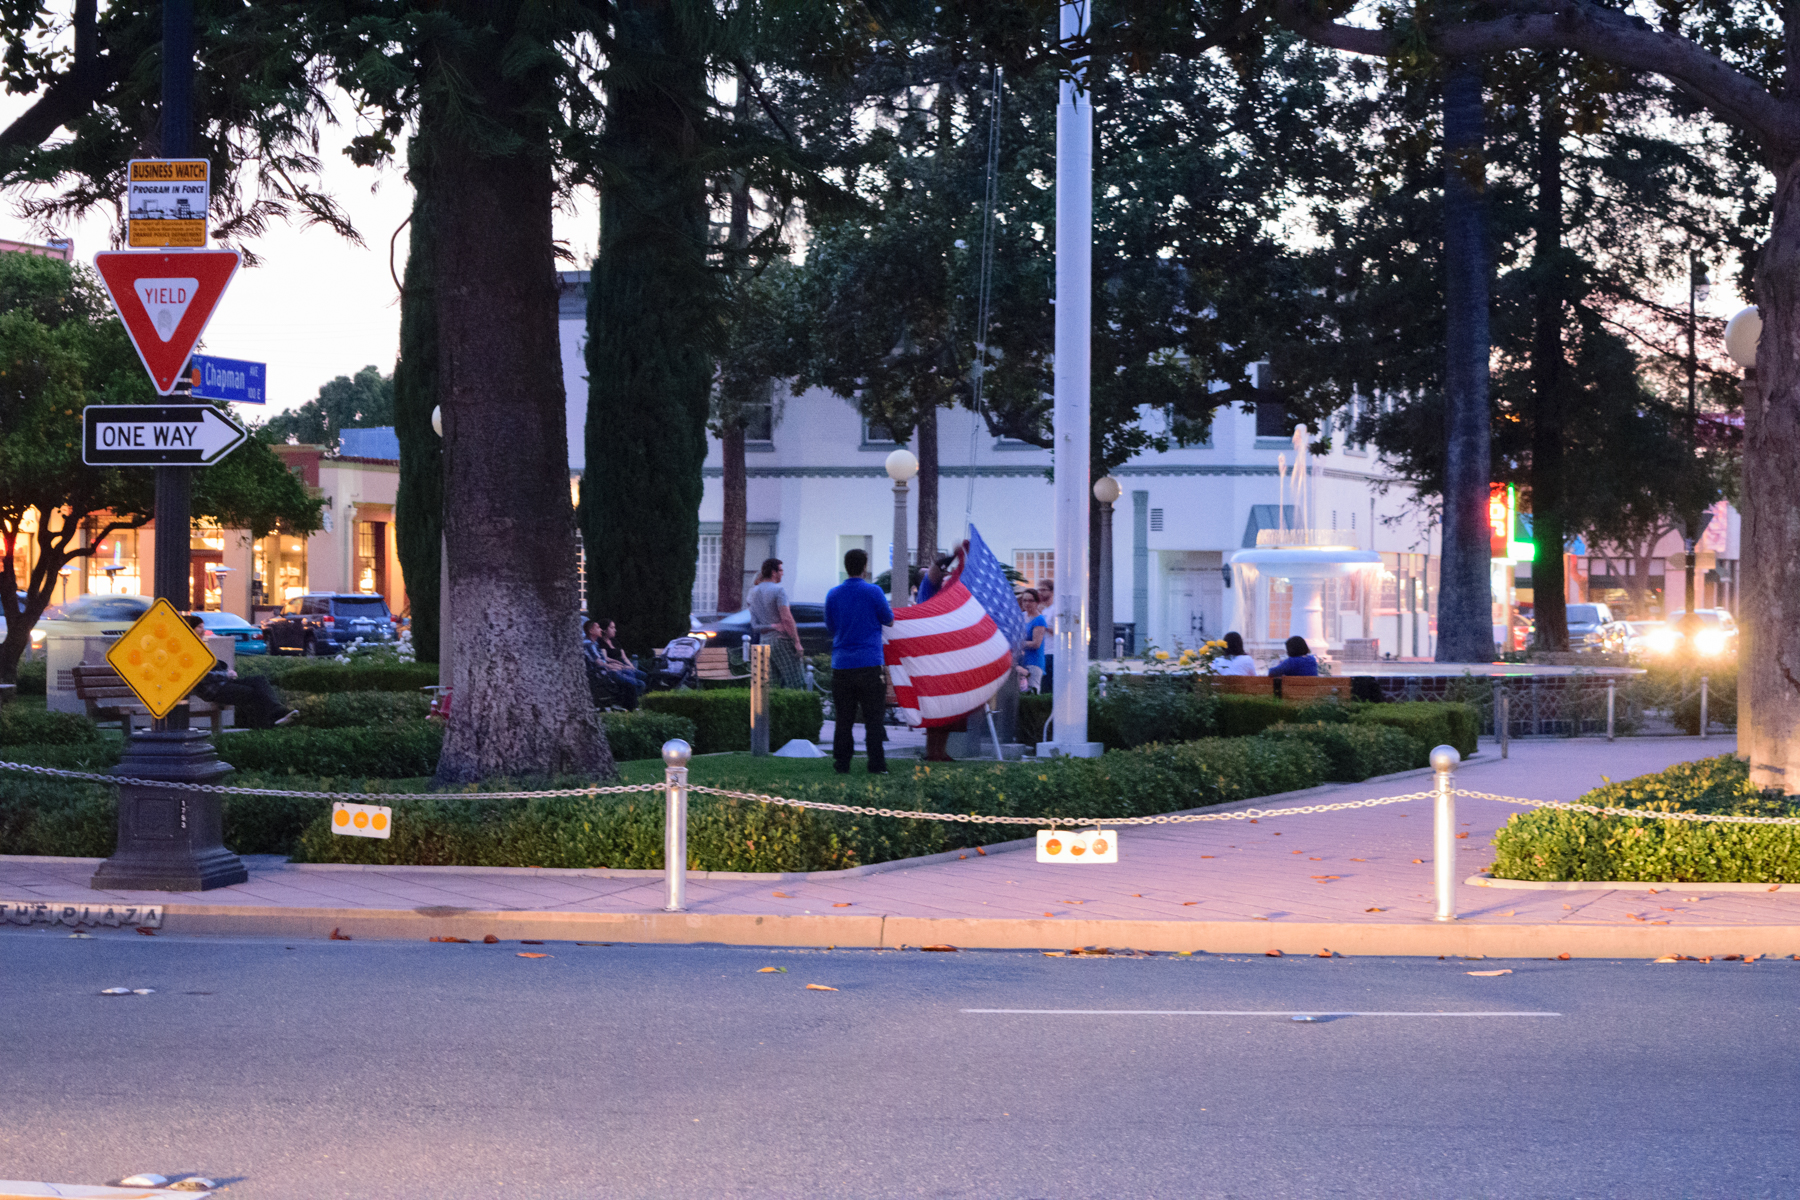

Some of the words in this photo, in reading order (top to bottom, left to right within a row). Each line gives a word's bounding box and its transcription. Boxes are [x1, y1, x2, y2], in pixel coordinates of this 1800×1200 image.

[133, 164, 173, 178] BUSINESS
[175, 164, 205, 178] WATCH
[132, 185, 170, 194] PROGRAM
[172, 186, 180, 194] IN
[182, 185, 204, 194] FORCE
[145, 288, 186, 304] YIELD
[205, 362, 245, 392] Chapman
[102, 426, 145, 447] ONE
[154, 426, 198, 447] WAY
